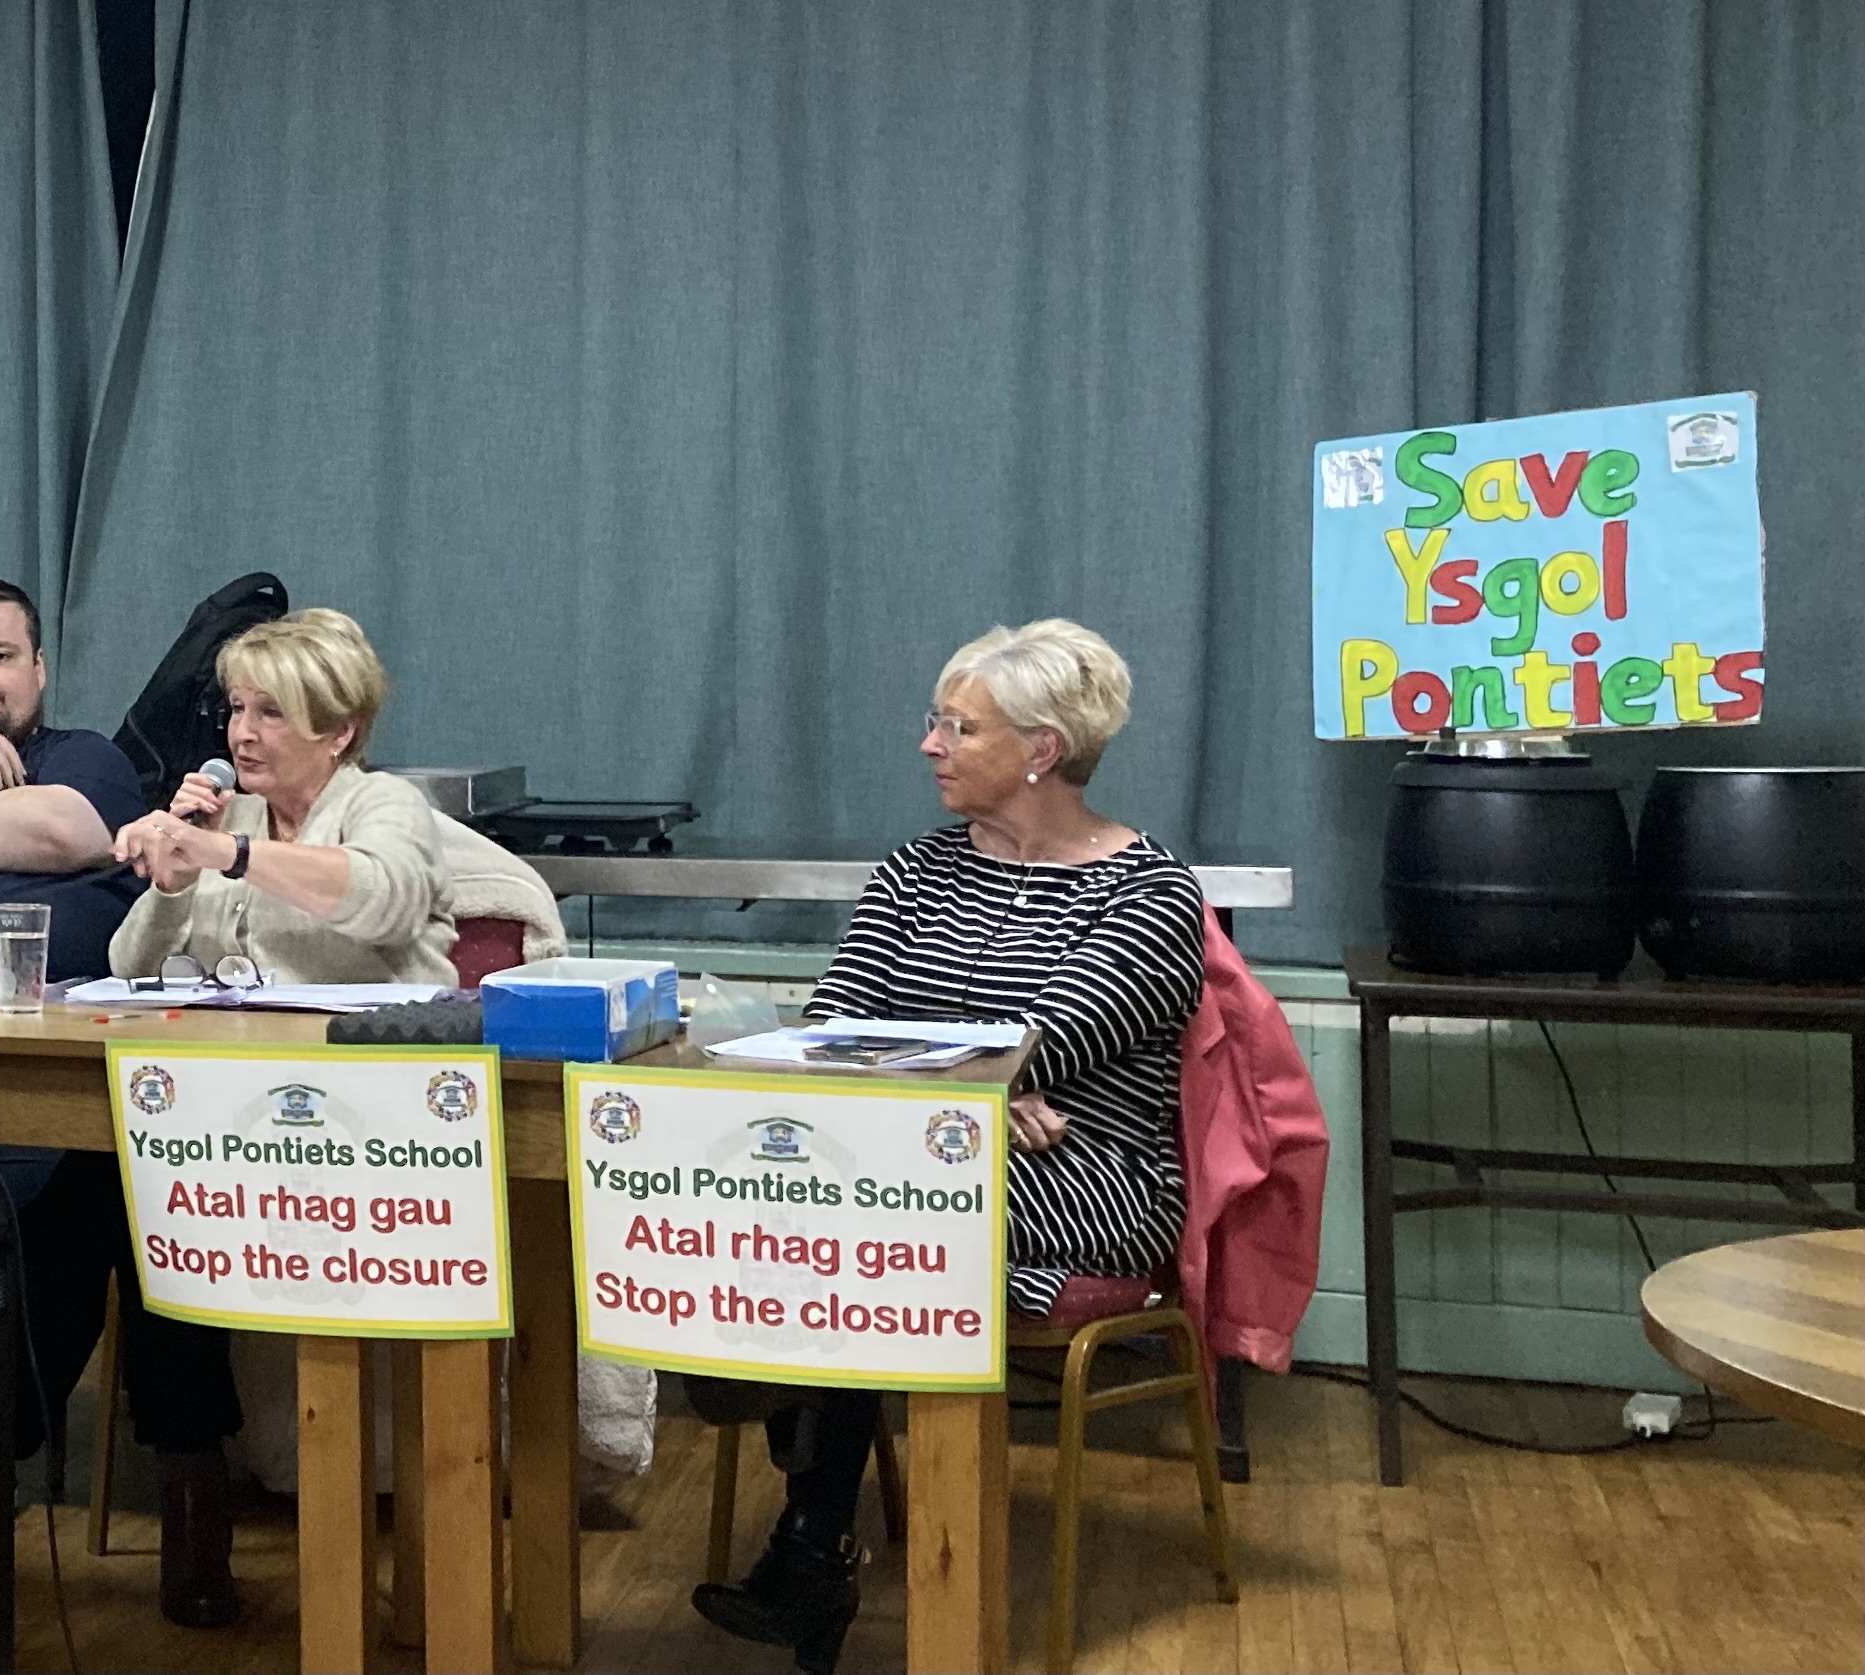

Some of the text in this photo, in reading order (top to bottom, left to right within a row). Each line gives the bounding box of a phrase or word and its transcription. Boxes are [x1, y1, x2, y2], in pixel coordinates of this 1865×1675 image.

[1395, 431, 1640, 528] Save
[1384, 520, 1628, 656] Ysgol
[1340, 632, 1764, 738] Pontiets
[129, 1131, 482, 1168] Ysgol Pontiets School
[167, 1180, 451, 1233] Atal rhag gau
[586, 1159, 982, 1213] Ysgol Pontiets School
[147, 1235, 487, 1286] Stop the closure
[625, 1215, 946, 1279] Atal rhag gau
[596, 1272, 981, 1338] Stop the closure
